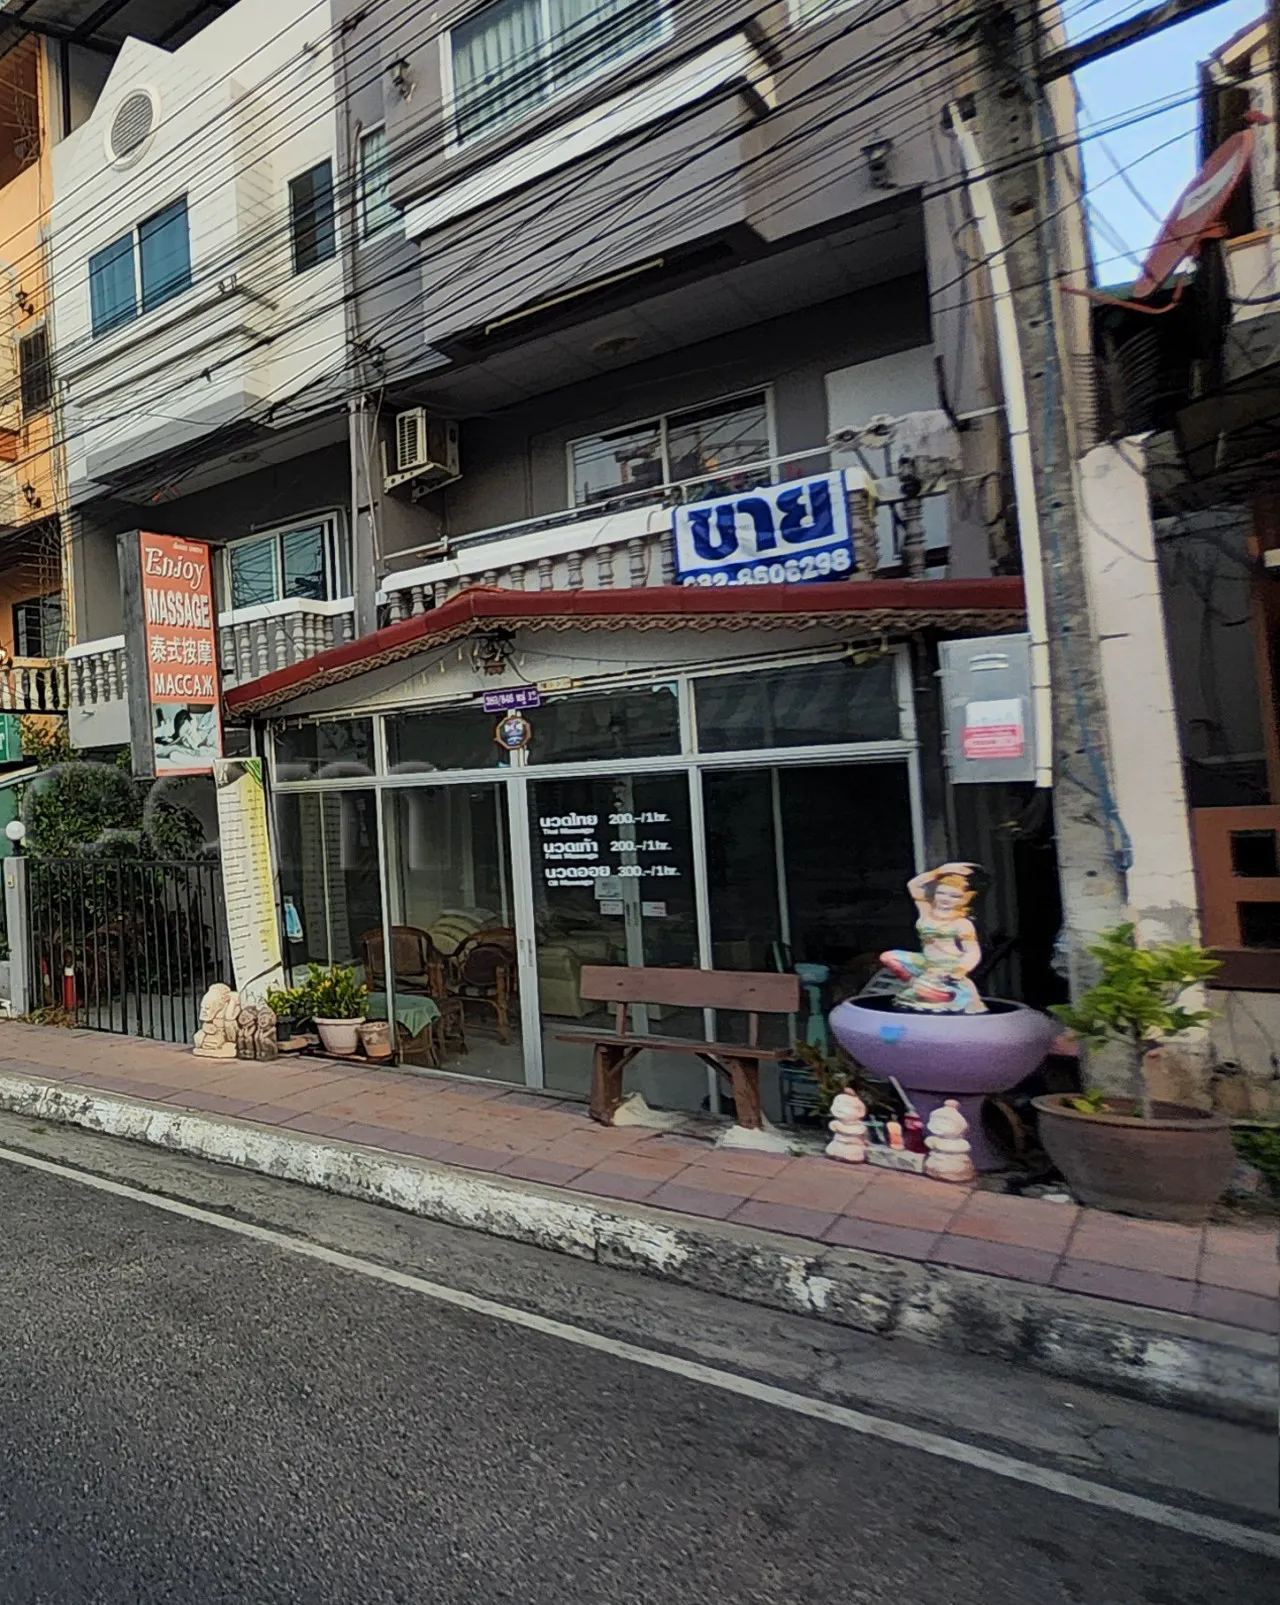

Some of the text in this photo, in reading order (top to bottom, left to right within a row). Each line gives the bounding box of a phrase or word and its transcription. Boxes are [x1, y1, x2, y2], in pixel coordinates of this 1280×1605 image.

[688, 480, 835, 560] ขาย
[145, 547, 206, 590] Enjoy
[145, 588, 211, 630] MASSAGE
[151, 634, 213, 667] 泰式按摩
[154, 672, 215, 698] МАССАЖ
[539, 812, 598, 828] นวดไทย
[543, 838, 599, 854] นวดเท้า
